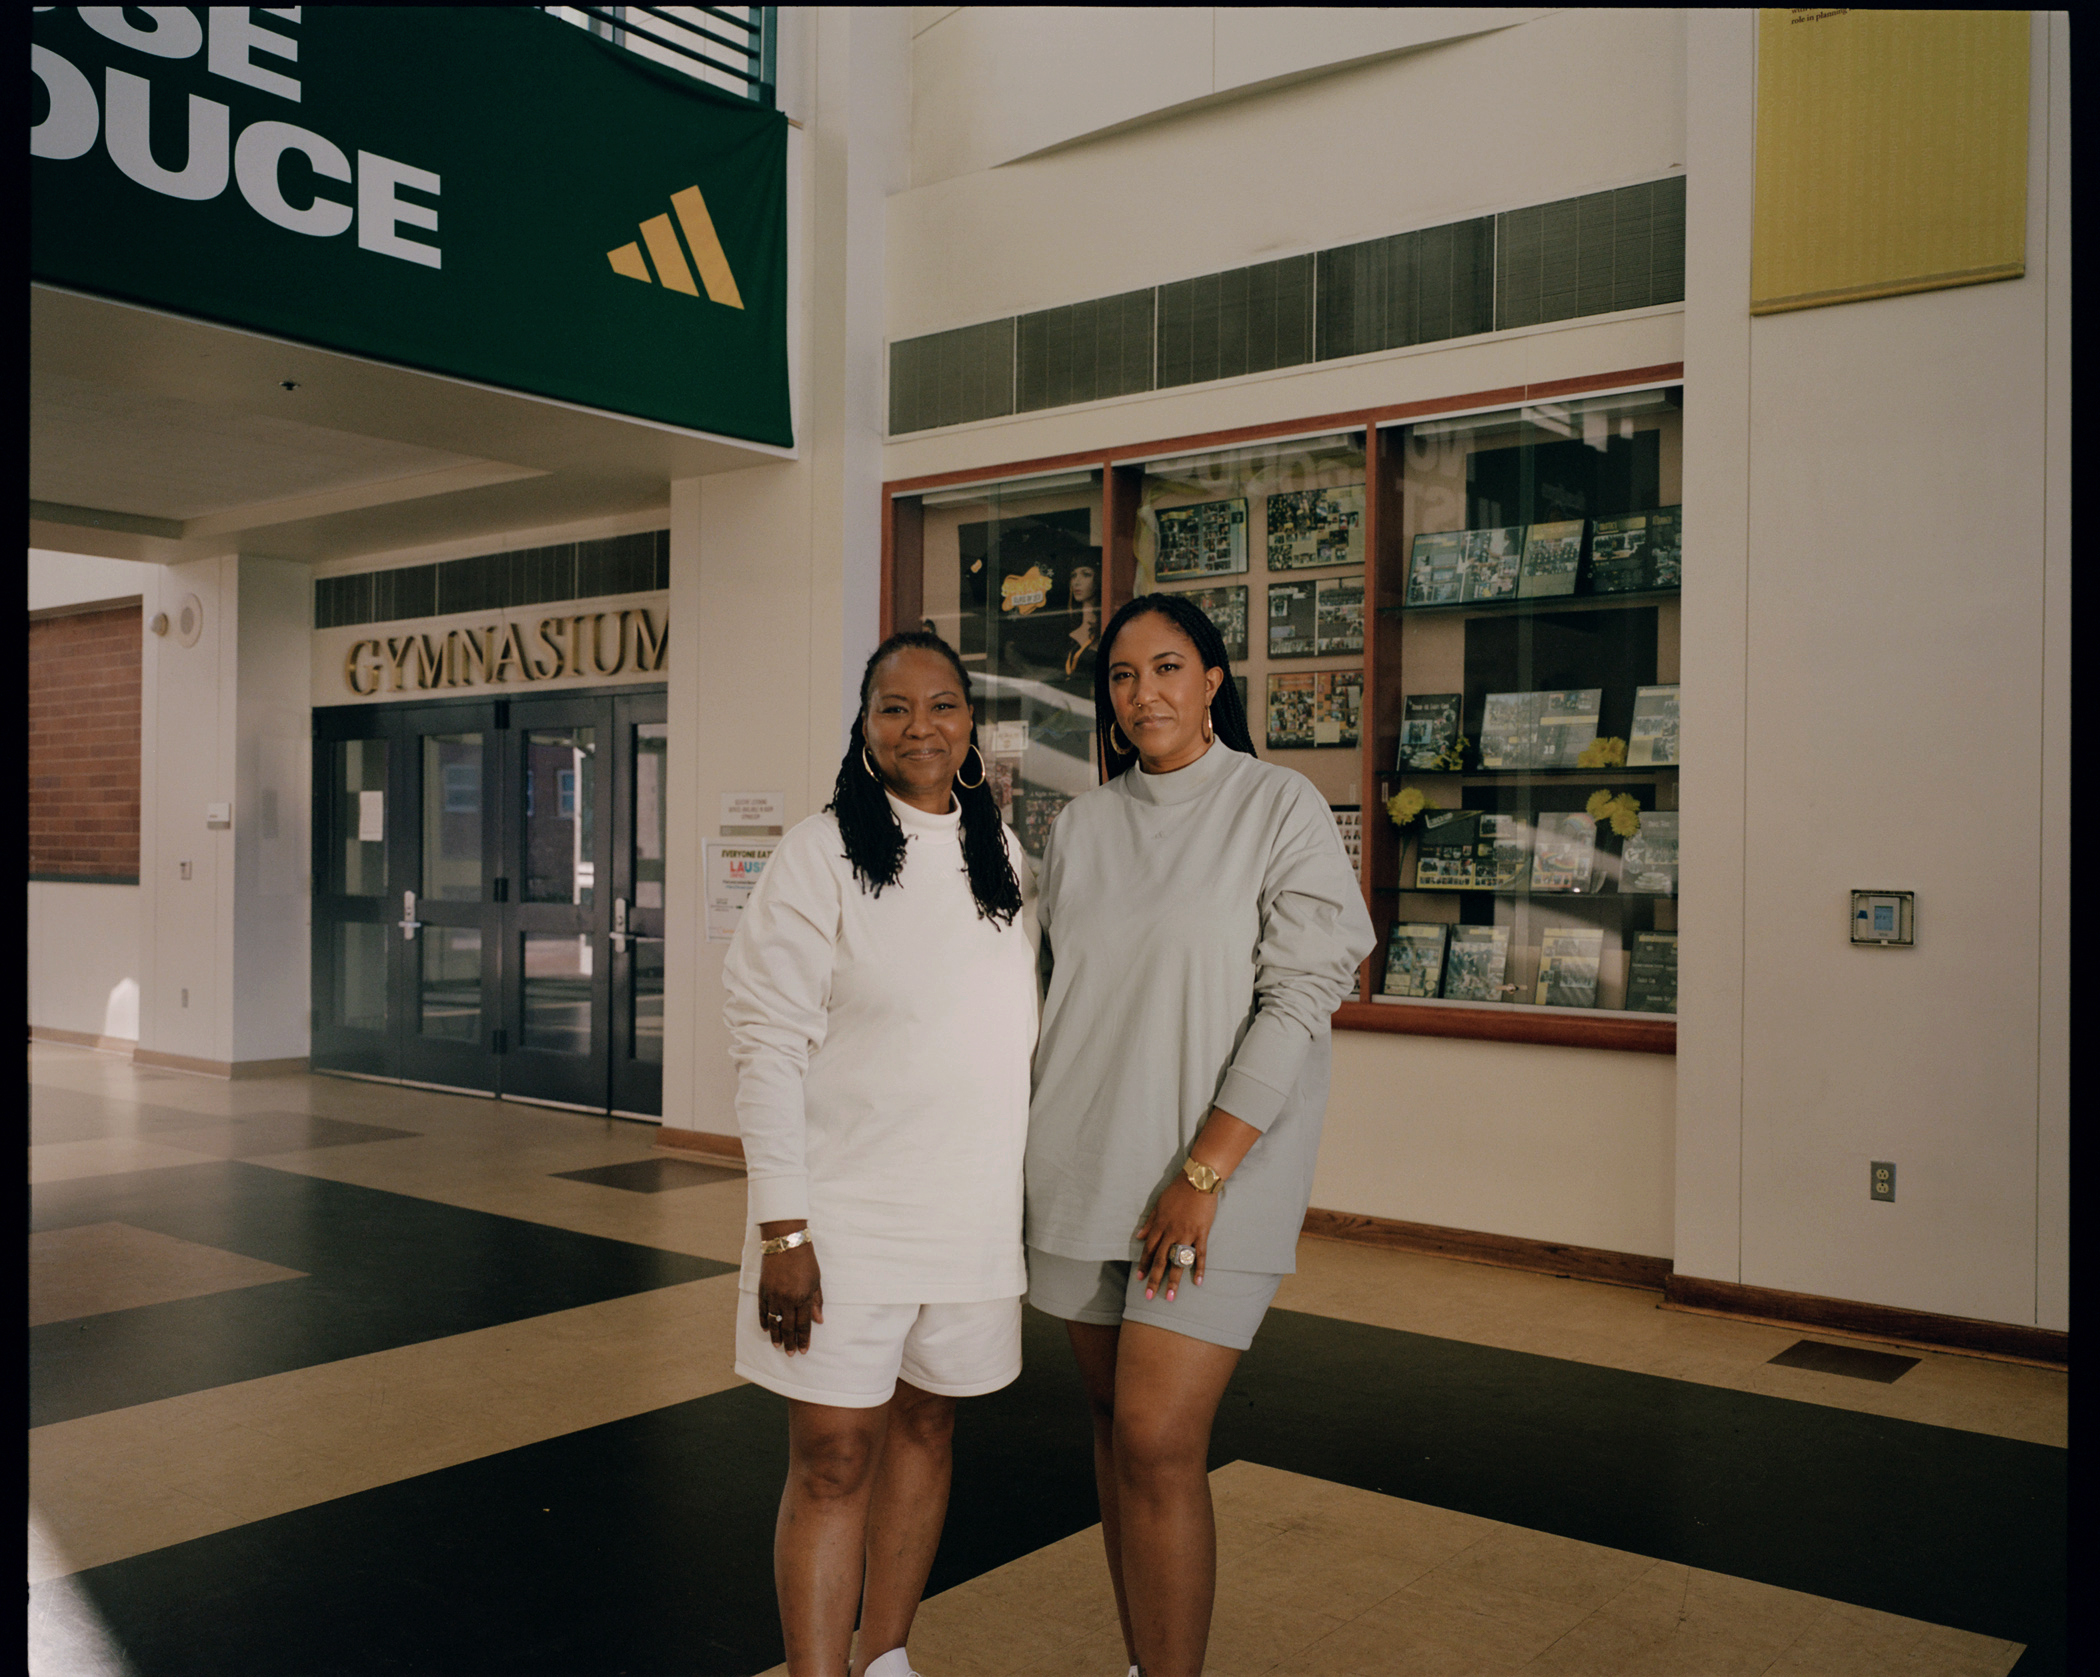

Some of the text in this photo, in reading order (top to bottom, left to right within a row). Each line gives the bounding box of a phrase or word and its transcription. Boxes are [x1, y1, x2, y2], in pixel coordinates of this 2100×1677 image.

[1791, 16, 1805, 24] role
[1815, 9, 1848, 22] planning
[345, 608, 670, 696] GYMNASIUM
[722, 849, 756, 858] EVERYONE
